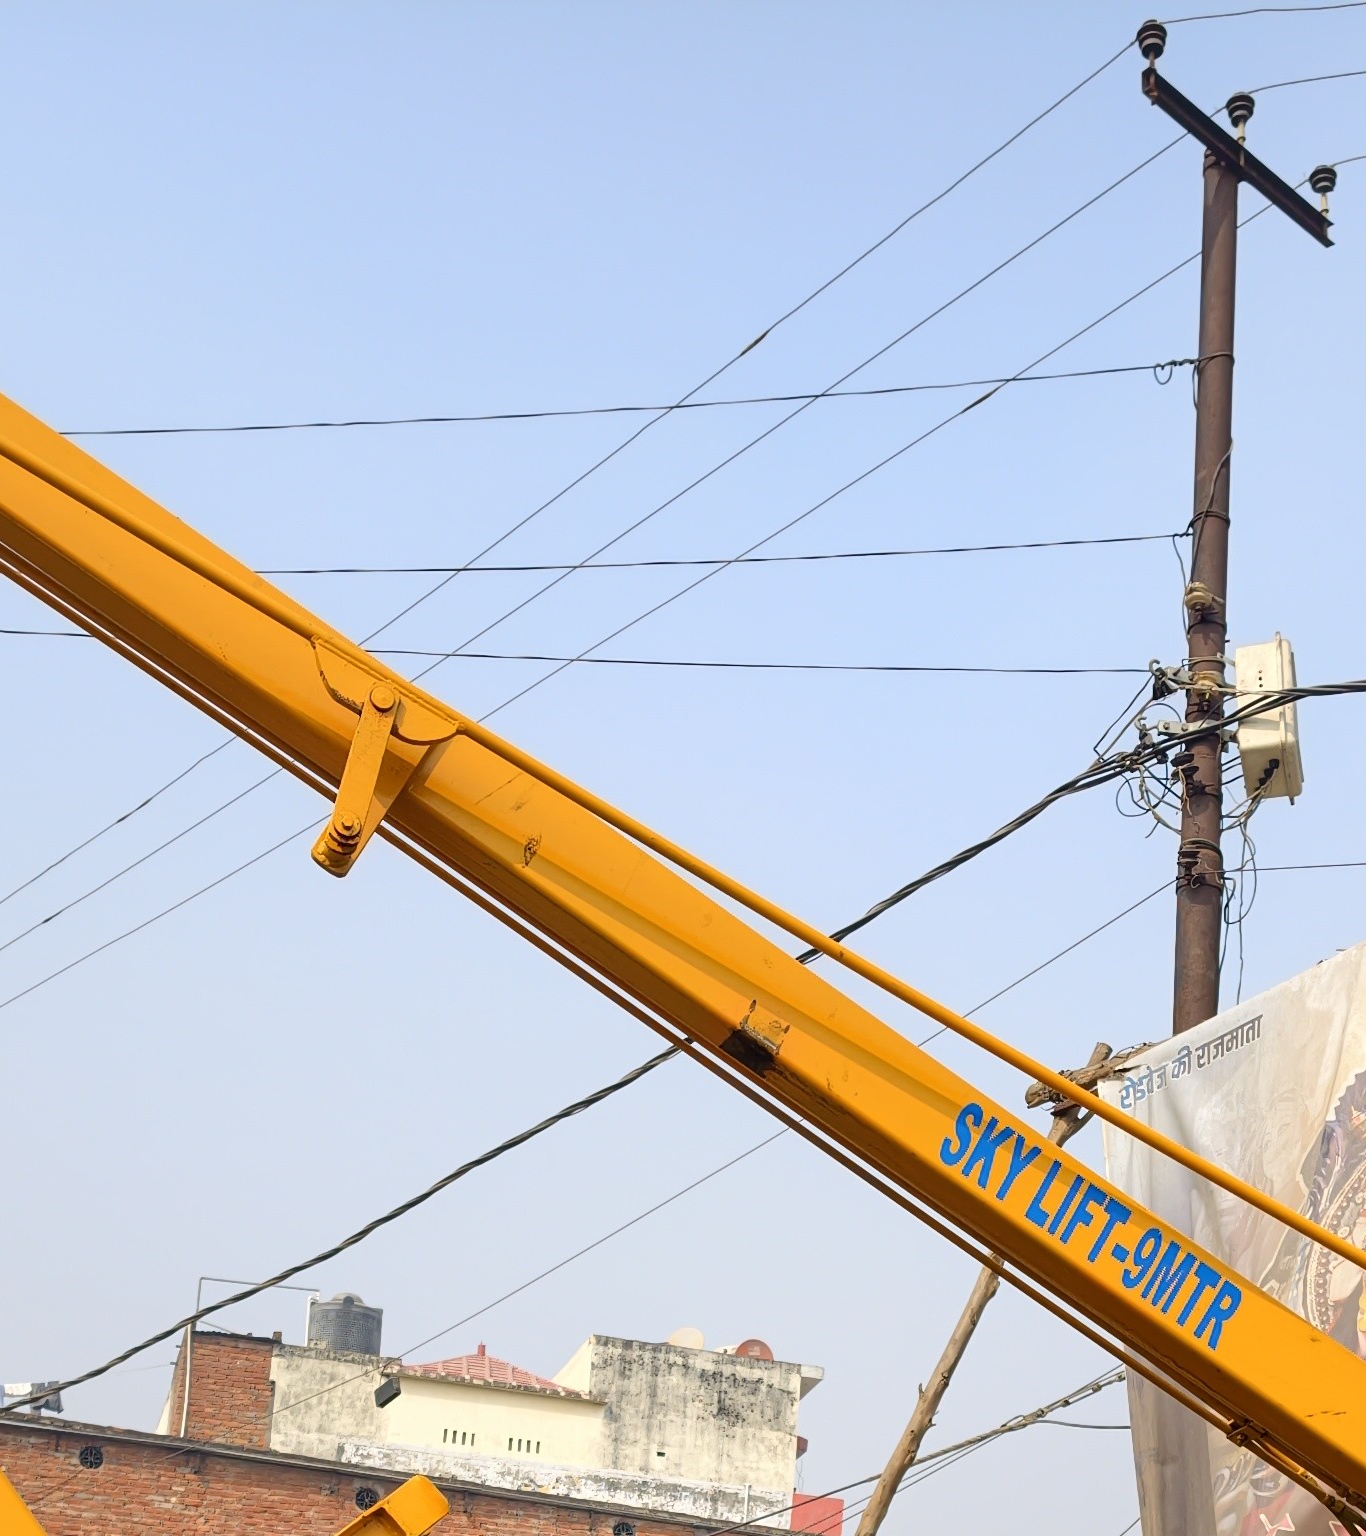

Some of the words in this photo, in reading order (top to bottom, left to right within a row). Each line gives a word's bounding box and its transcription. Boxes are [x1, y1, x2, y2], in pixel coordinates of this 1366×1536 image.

[1172, 1045, 1193, 1079] की
[1195, 1014, 1264, 1069] राजमाता
[939, 1102, 1042, 1202] SKY
[1025, 1159, 1243, 1351] LIFT-9MTR
